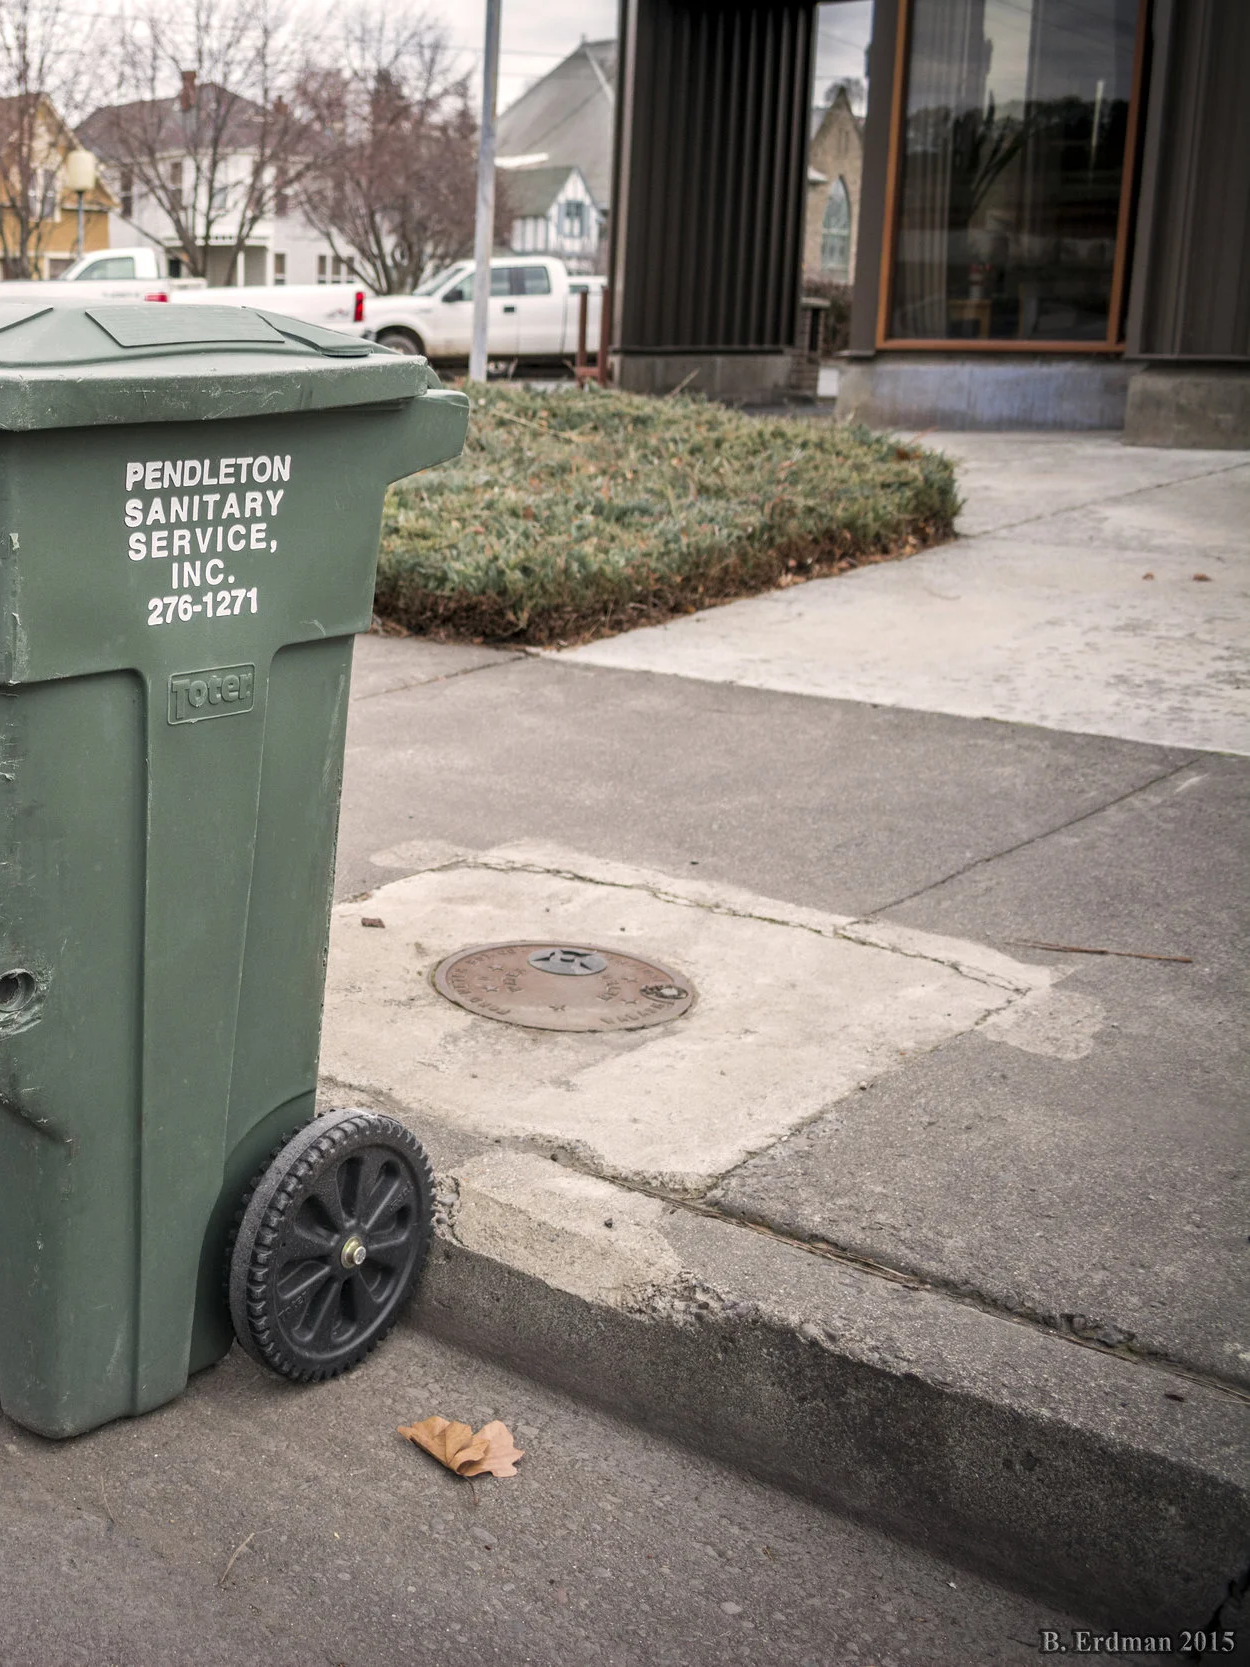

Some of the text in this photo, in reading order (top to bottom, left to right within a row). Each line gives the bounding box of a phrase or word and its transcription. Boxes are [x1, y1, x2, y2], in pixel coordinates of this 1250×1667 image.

[125, 455, 292, 492] PENDLETON
[124, 489, 285, 528] SANITARY
[128, 523, 278, 561] SERVICE,
[171, 558, 235, 590] INC.
[147, 587, 258, 626] 276-1271
[172, 673, 253, 719] Toter
